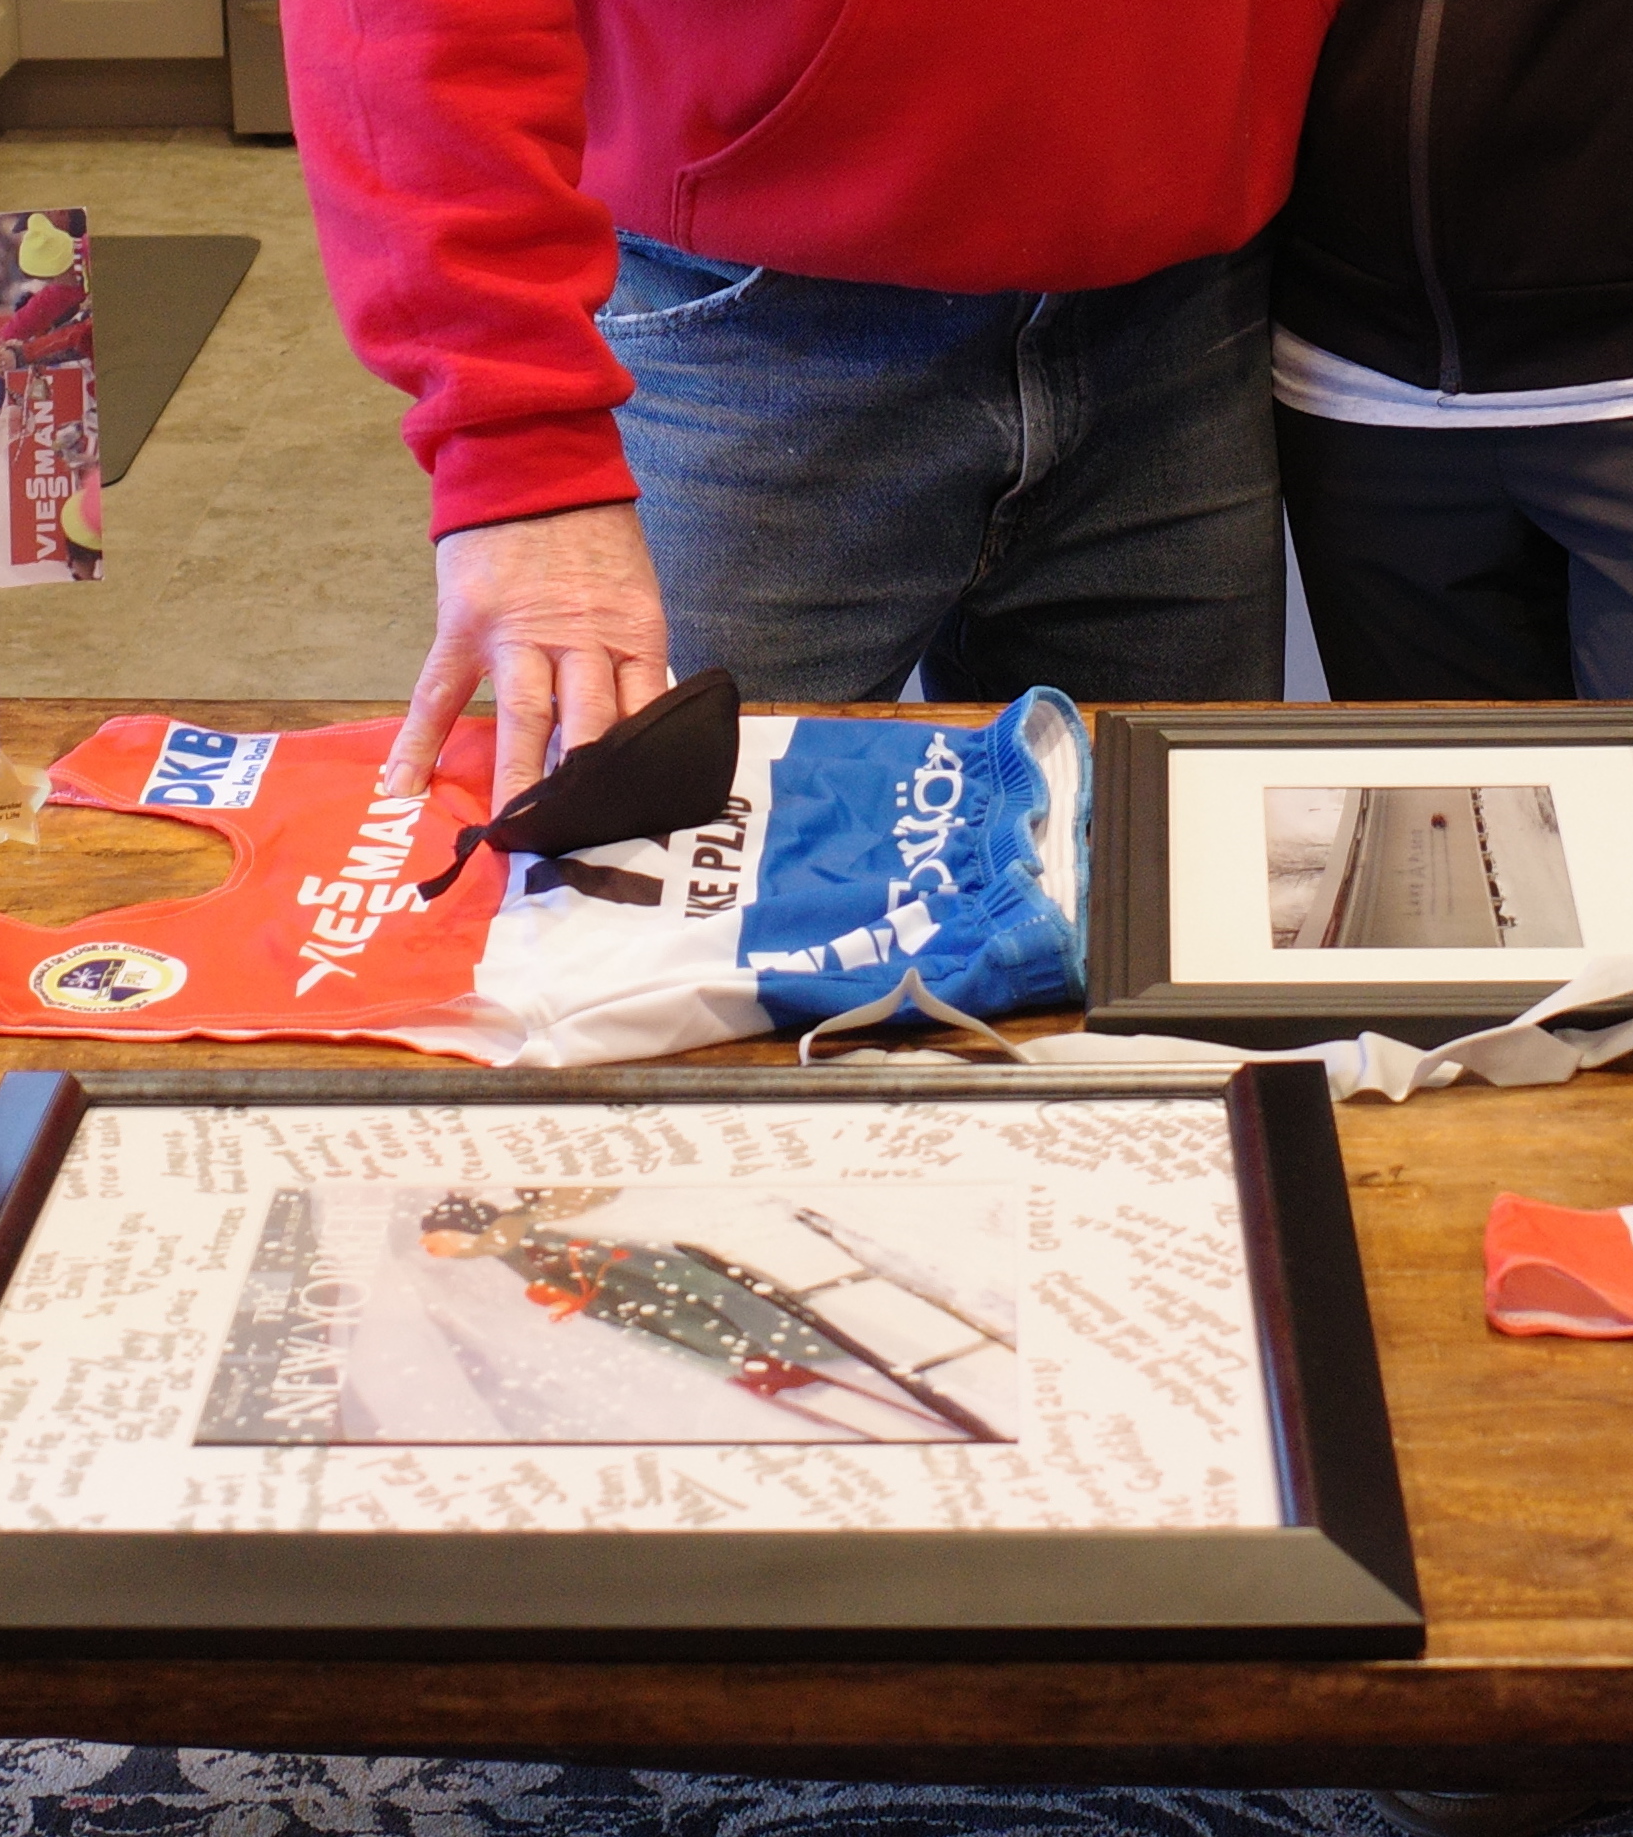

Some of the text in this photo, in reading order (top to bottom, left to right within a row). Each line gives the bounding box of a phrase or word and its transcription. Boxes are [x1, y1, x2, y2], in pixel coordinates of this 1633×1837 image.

[25, 373, 70, 561] VIESSMAN
[146, 721, 239, 808] DKB
[246, 737, 274, 763] Bank
[294, 764, 440, 998] VIESSMAN
[1026, 1199, 1062, 1252] Grace
[261, 1335, 349, 1422] NEW
